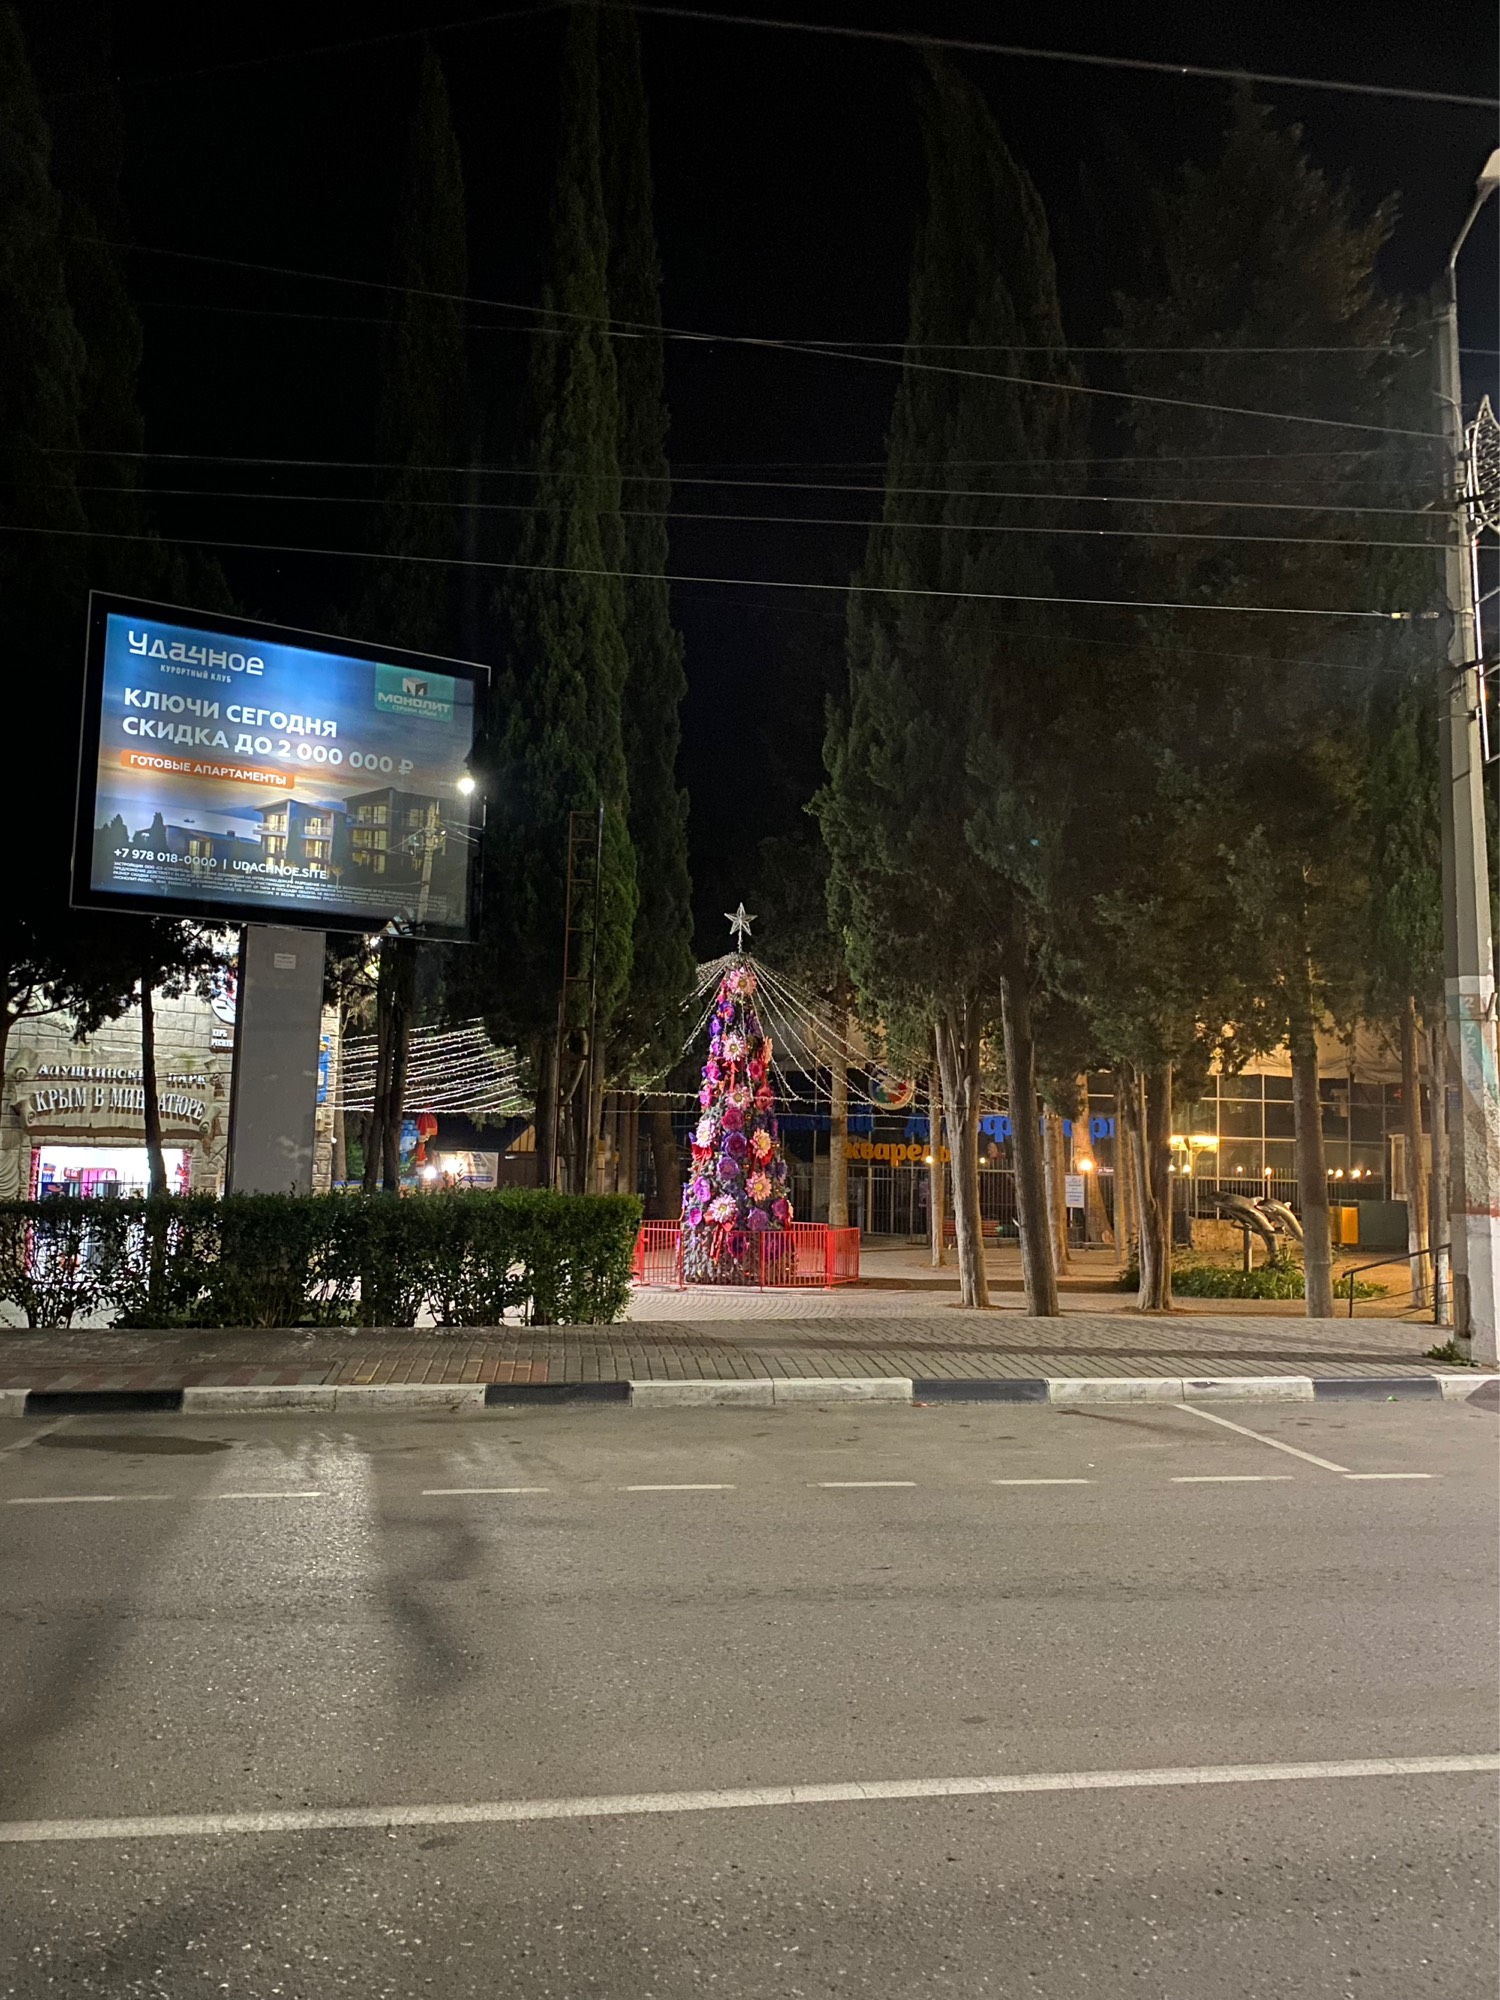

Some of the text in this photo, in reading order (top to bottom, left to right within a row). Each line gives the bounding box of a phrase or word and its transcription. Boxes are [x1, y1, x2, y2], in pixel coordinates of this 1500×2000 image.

[160, 664, 232, 683] КУРОРТНЫЙ КЛУБ
[124, 687, 338, 738] КЛЮЧИ СЕГОДНЯ
[122, 716, 229, 748] СКИДКА
[234, 733, 273, 755] ДО
[277, 739, 291, 758] 2
[297, 743, 343, 765] 000
[349, 751, 393, 773] 000
[130, 754, 287, 785] ГОТОВЫЕ АПАРТАМЕНТЫ
[113, 847, 217, 868] +7 978 018-0000
[233, 860, 328, 880] UDACHNOE.SITE
[35, 1087, 205, 1120] КРЫМ В МИНАТЮРЕ
